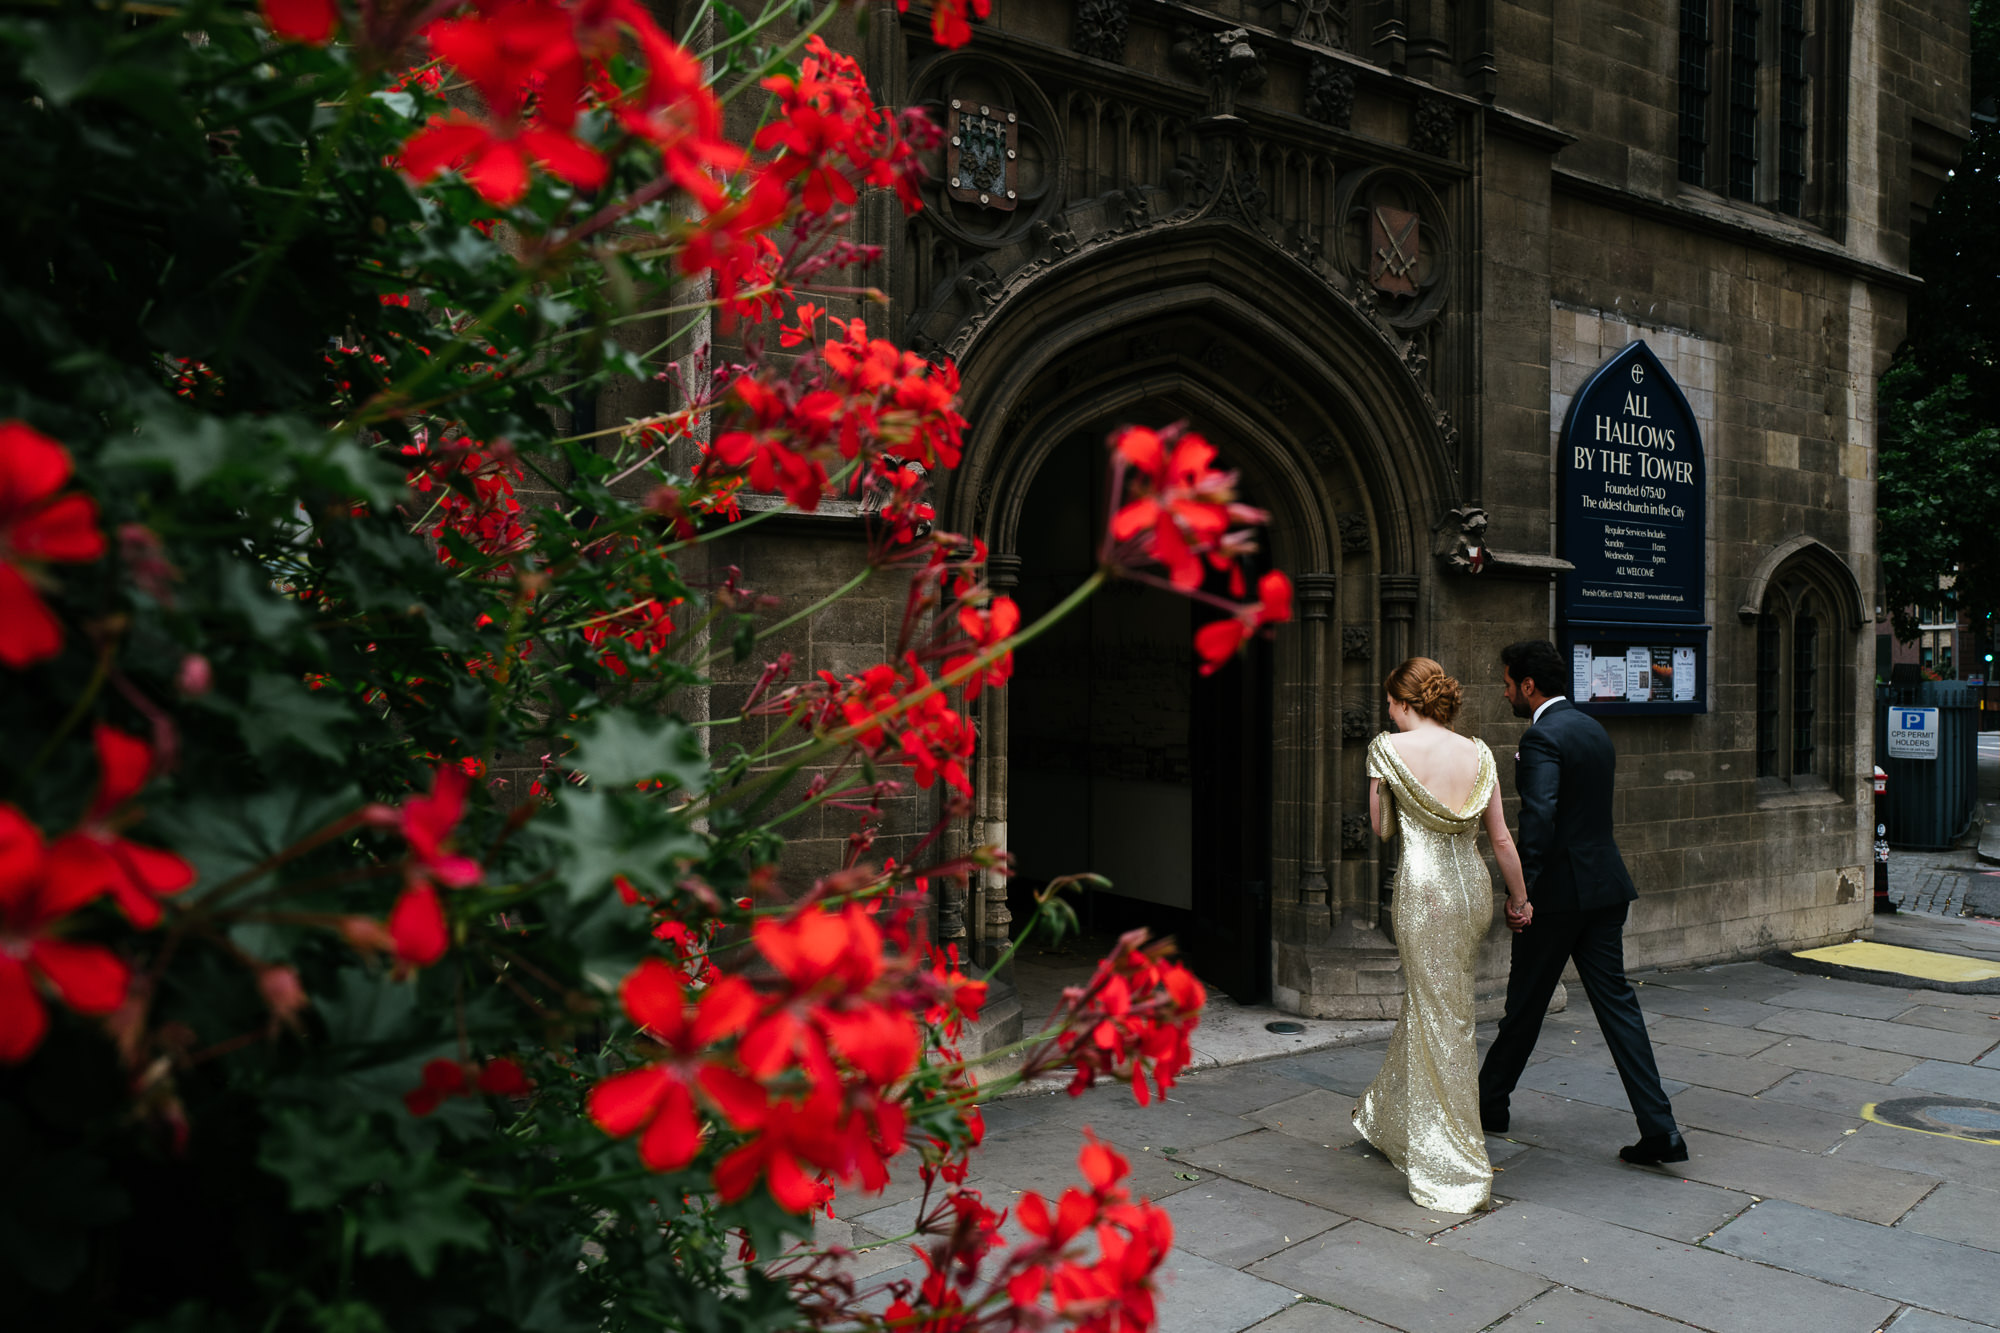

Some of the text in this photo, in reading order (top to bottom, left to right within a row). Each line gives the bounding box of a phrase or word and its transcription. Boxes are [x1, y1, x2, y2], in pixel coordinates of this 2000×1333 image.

[1623, 390, 1651, 418] ALL
[1595, 415, 1675, 451] HALLOWS
[1574, 446, 1693, 485] BY THE TOWER
[1605, 481, 1666, 499] Founded 675AD
[1581, 495, 1685, 520] The oldest church in the City
[1604, 524, 1625, 537] Regular
[1626, 527, 1646, 538] Services
[1604, 538, 1625, 550] Sunday
[1604, 550, 1635, 562] Wednesday
[1616, 566, 1655, 577] ALL WELCOME
[1582, 588, 1597, 597] Parish
[1906, 713, 1920, 728] P
[1891, 730, 1934, 739] CPS PERMIT
[1895, 739, 1930, 747] HOLDERS
